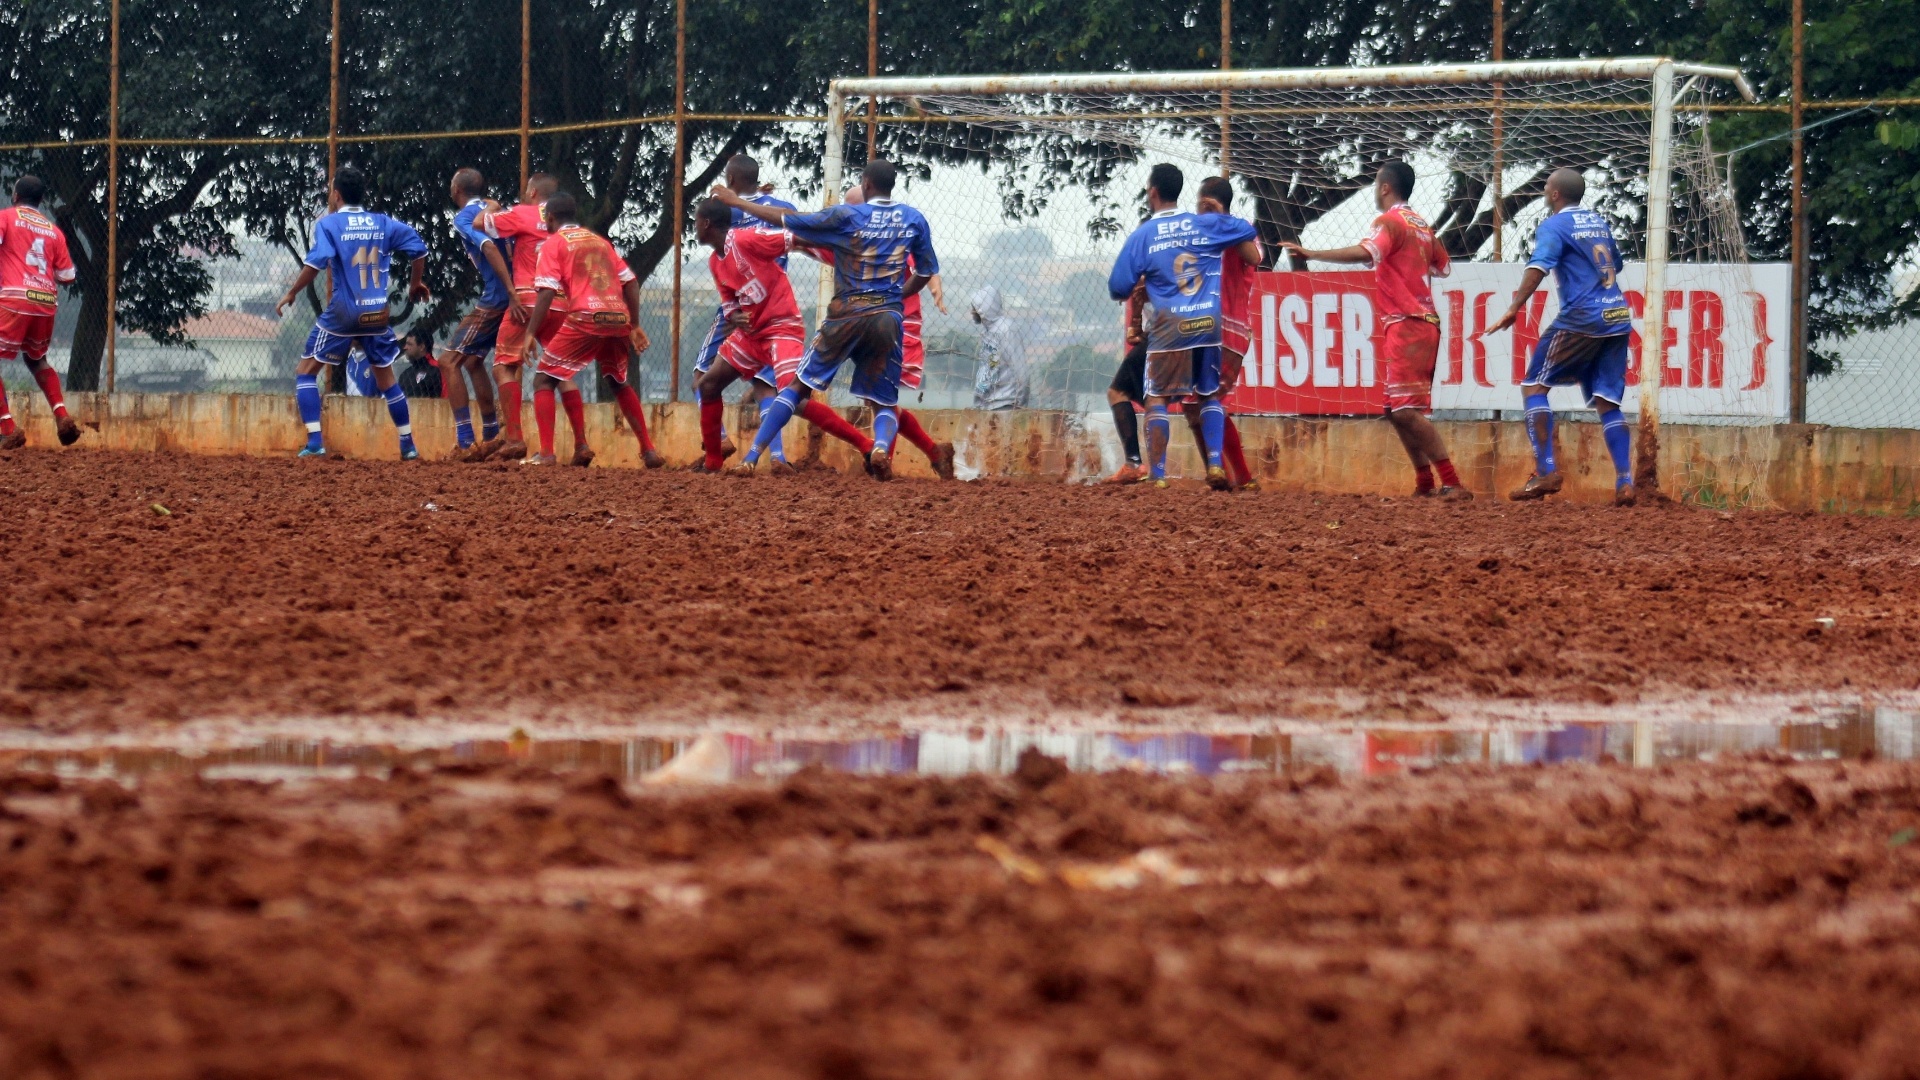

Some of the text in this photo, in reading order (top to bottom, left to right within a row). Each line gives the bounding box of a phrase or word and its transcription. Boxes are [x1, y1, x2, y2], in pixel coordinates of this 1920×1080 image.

[347, 216, 375, 227] EPC
[870, 210, 903, 223] EPC
[1157, 219, 1193, 235] EPC
[25, 238, 47, 275] 4
[1148, 239, 1188, 255] NAPOLI
[351, 245, 380, 290] 11
[1173, 253, 1204, 297] 6
[1235, 293, 1376, 388] AISER
